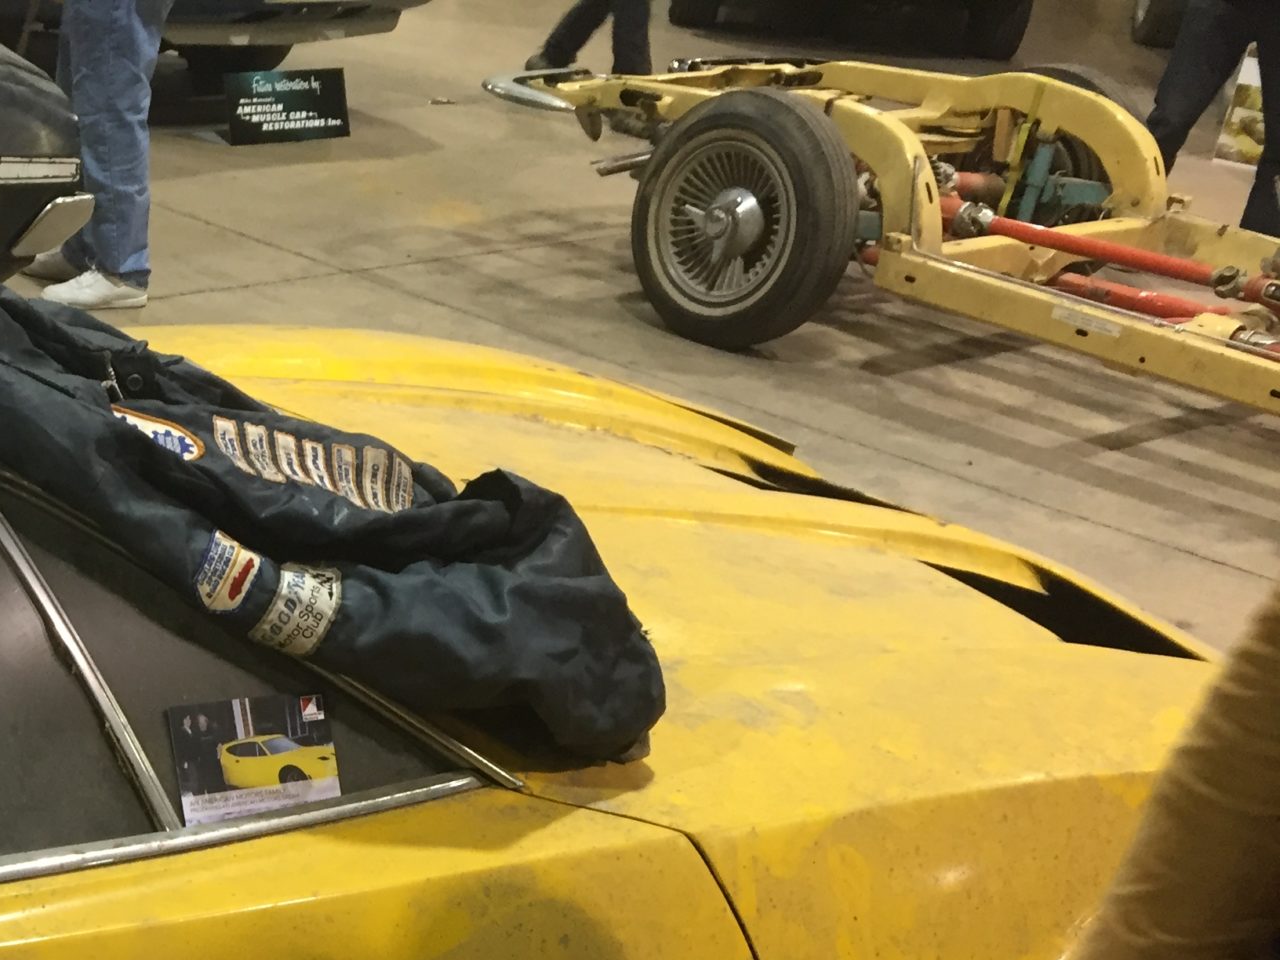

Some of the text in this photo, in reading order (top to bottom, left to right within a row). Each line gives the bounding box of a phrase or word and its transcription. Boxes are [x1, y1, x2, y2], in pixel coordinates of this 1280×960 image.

[236, 103, 284, 114] AMERICAN
[251, 111, 307, 122] MUSCLE CAR
[262, 118, 326, 131] RESTORATIONS
[299, 585, 321, 622] Sports
[302, 611, 324, 639] Club
